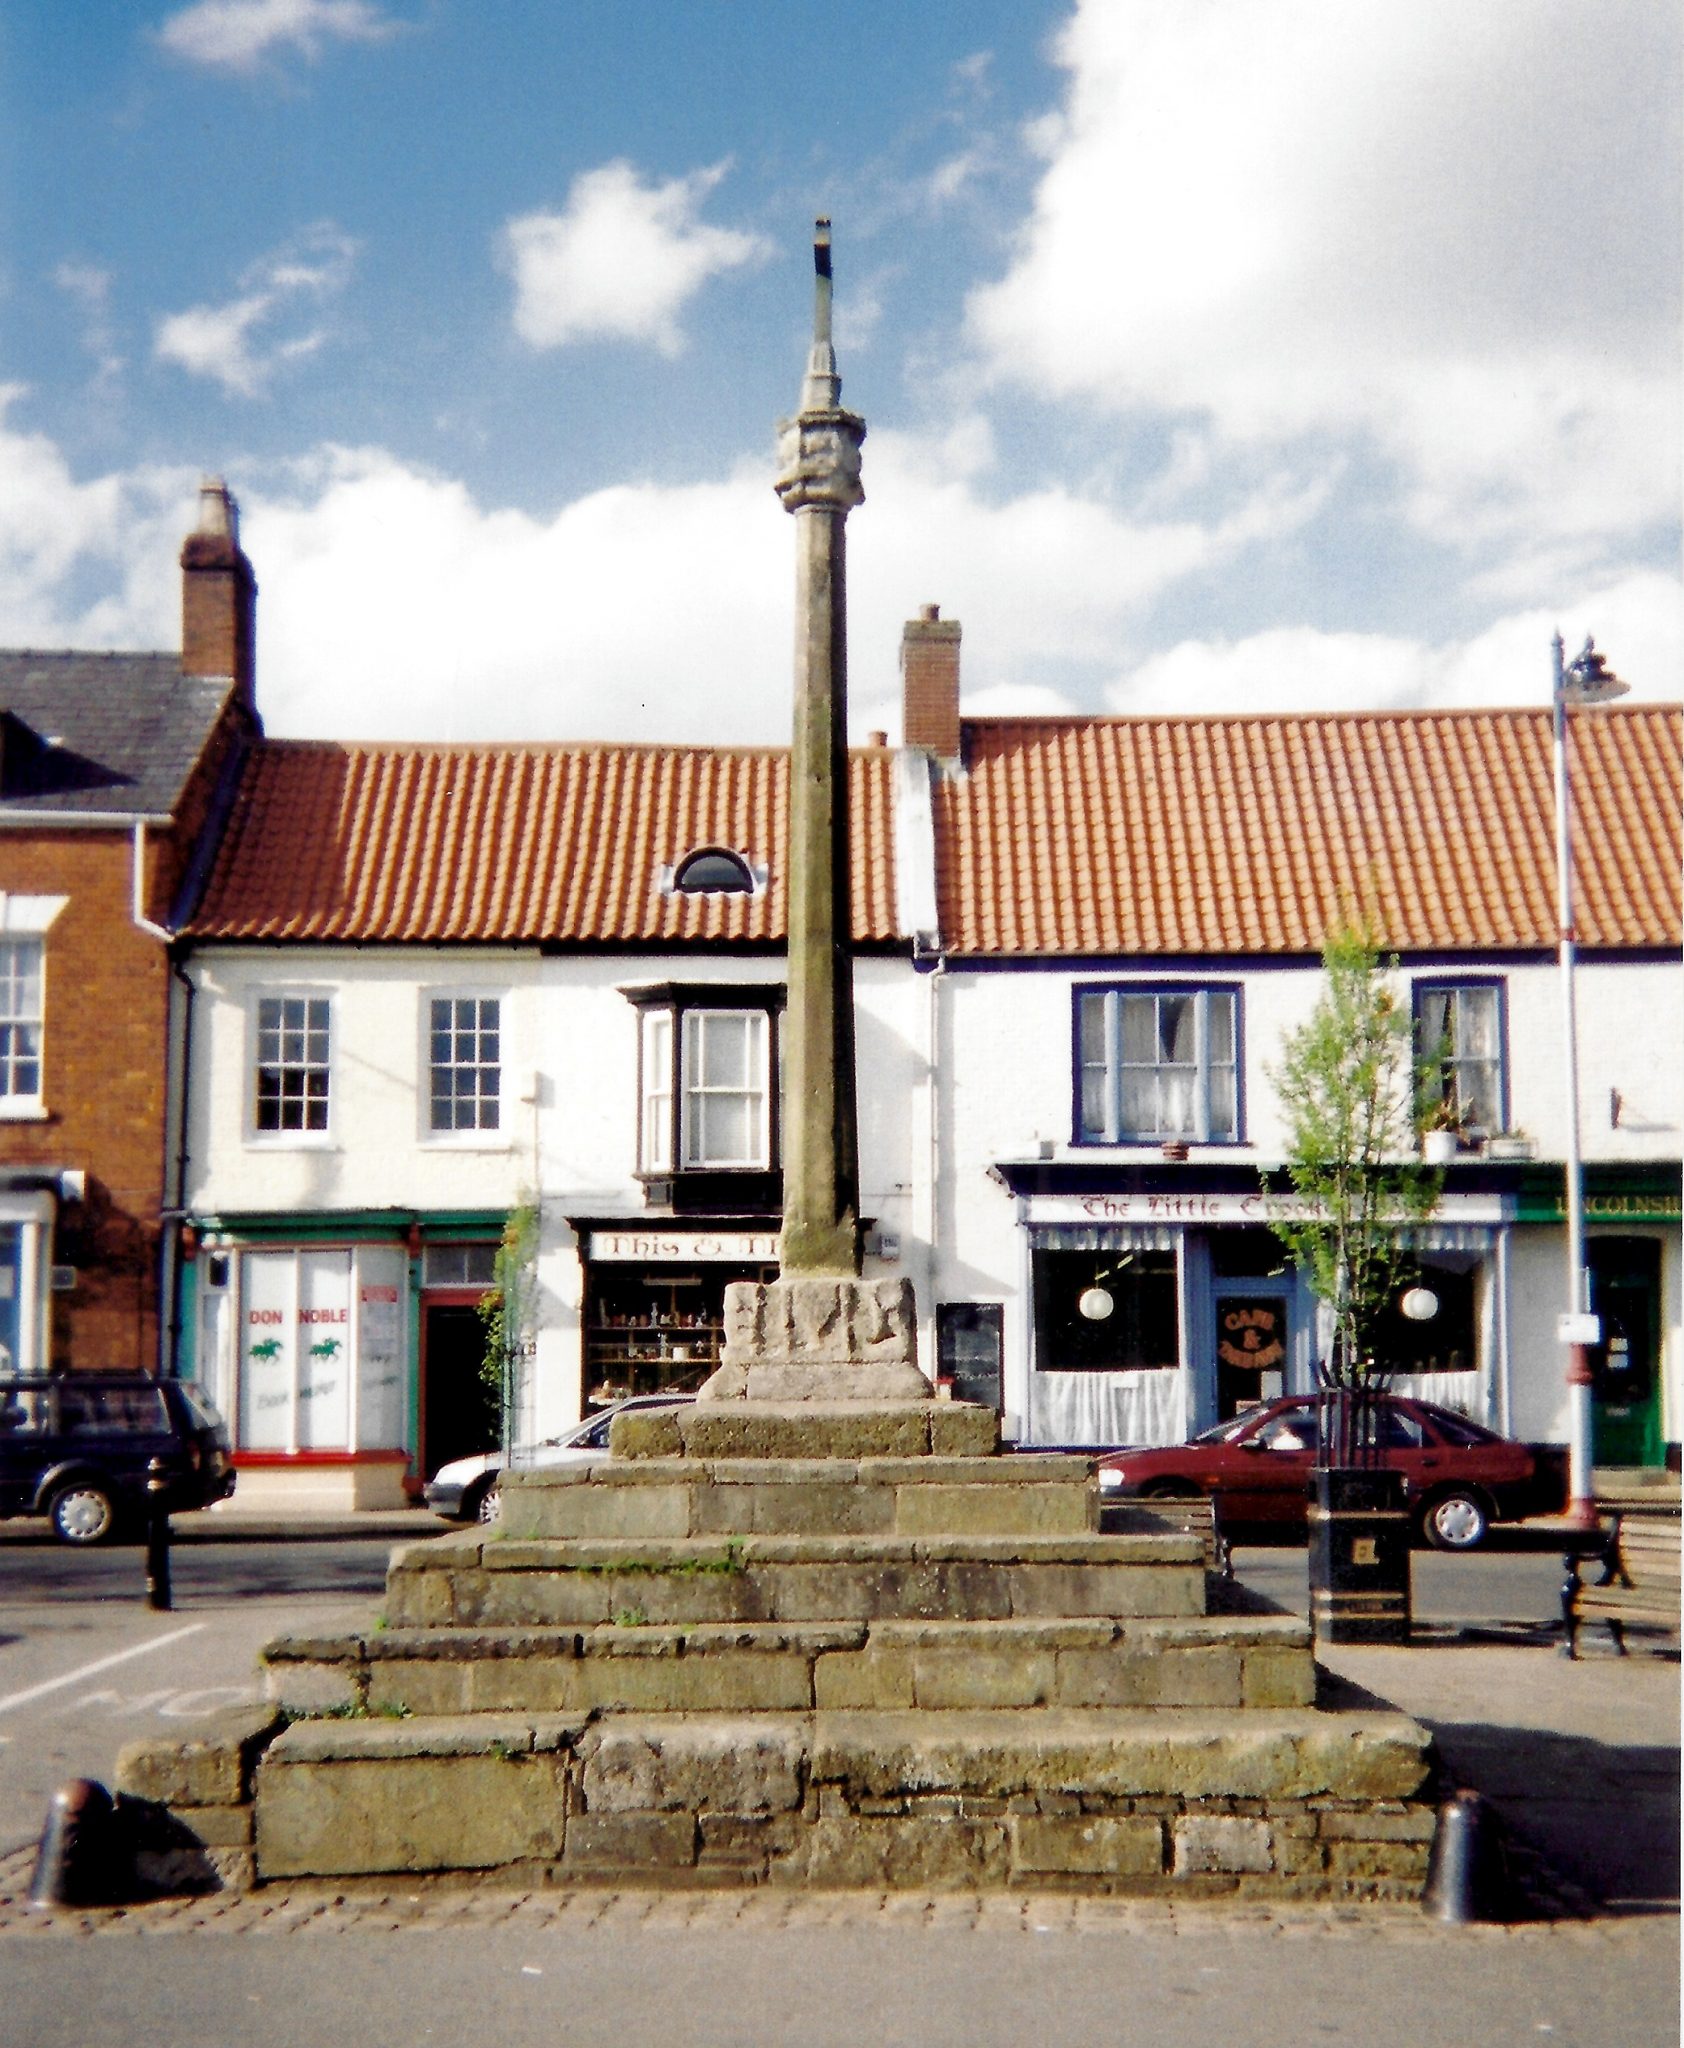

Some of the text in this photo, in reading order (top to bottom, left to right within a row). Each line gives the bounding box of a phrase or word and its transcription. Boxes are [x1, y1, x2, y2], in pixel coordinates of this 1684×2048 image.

[1081, 1195, 1131, 1217] The
[1149, 1195, 1221, 1217] Little
[604, 1236, 679, 1260] This
[694, 1237, 723, 1256] &
[249, 1308, 348, 1325] DON NOBLE
